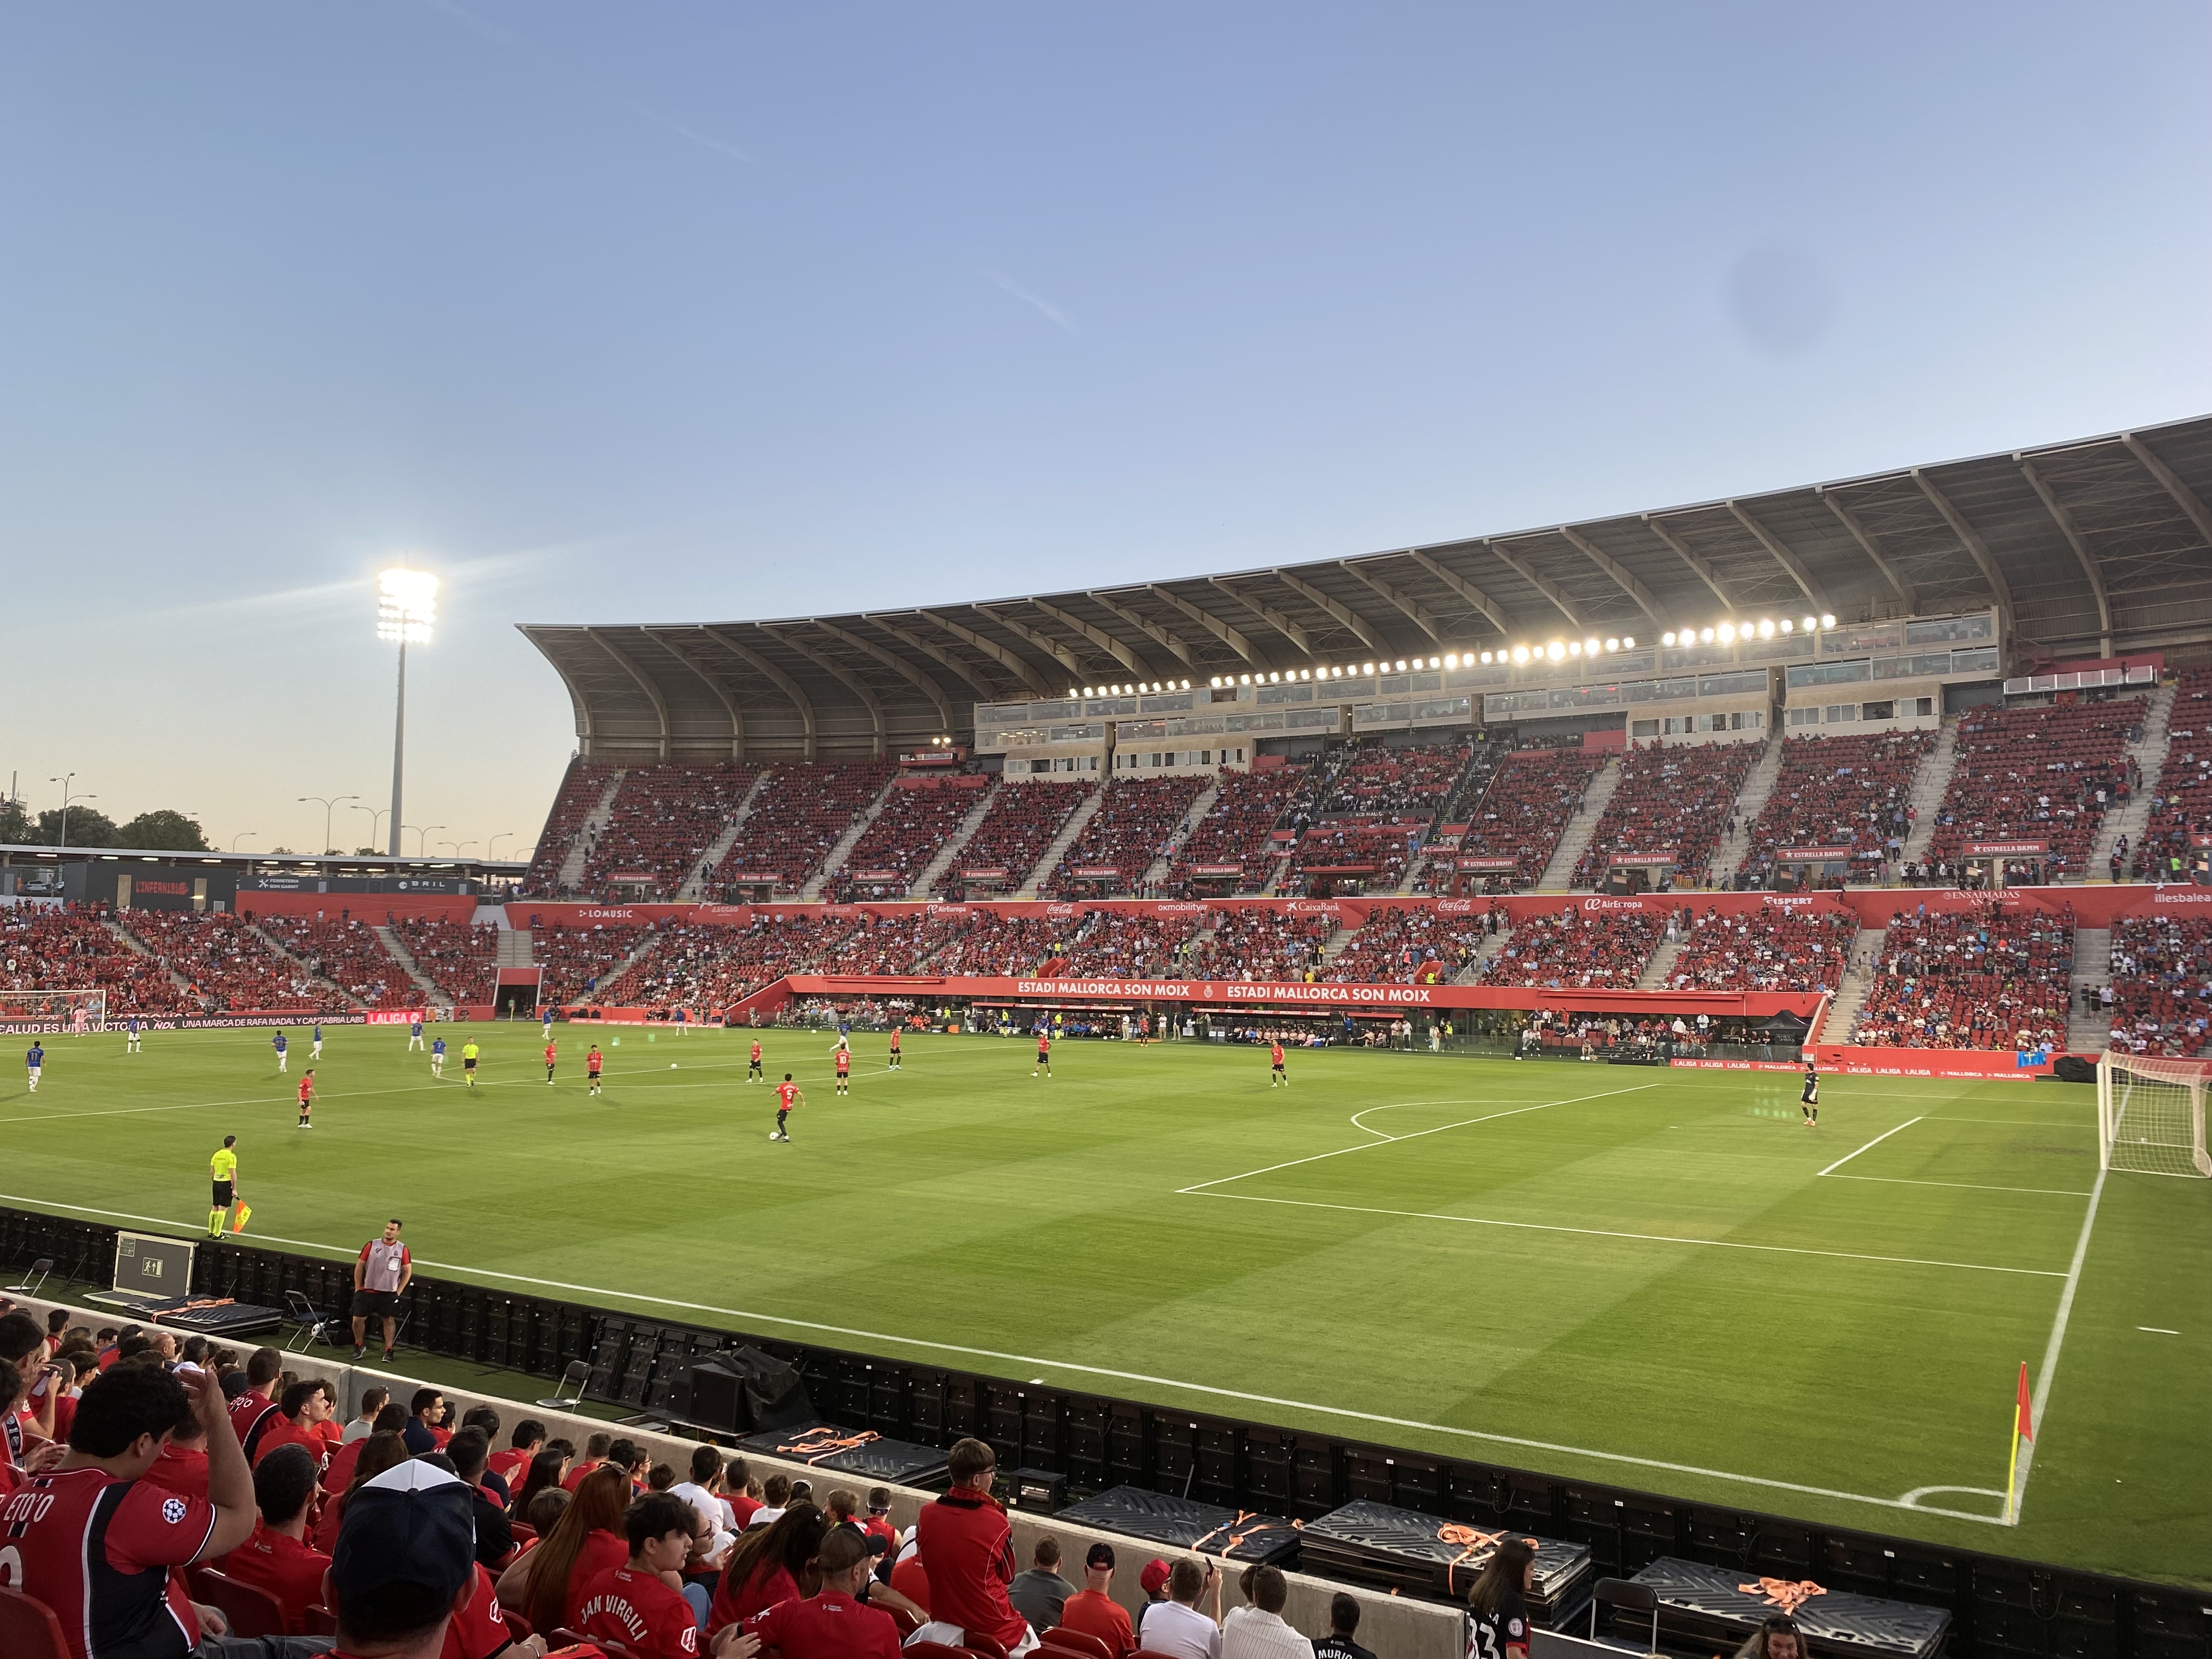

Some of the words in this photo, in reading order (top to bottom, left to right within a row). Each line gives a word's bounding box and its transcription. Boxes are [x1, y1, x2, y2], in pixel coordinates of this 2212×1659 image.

[1953, 890, 2020, 900] ENSAIMADAS
[1047, 904, 1074, 914] Coca-Cola
[1298, 902, 1341, 911] CaixaBank
[1438, 899, 1472, 911] Coca-Cola
[1018, 981, 1055, 992] ESTADI
[1058, 983, 1121, 995] MALLORCA
[1125, 984, 1152, 995] SON
[1154, 984, 1190, 996] MOIX
[1227, 986, 1270, 998] ESTADI
[1273, 987, 1349, 1000] MALLORCA
[1352, 988, 1385, 1001] SON
[1389, 989, 1431, 1002] MOIX
[370, 1013, 408, 1024] LALIGA
[43, 1024, 59, 1033] ES
[182, 1020, 201, 1028] UNA
[202, 1019, 234, 1028] MARCA
[247, 1018, 268, 1026] RAFA
[269, 1017, 296, 1025] NADAL
[302, 1016, 346, 1025] CANTABRIA
[31, 1052, 38, 1061] 11
[839, 1056, 846, 1064] 10
[787, 1090, 792, 1100] 5
[3, 1493, 54, 1522] ETO'O
[581, 1595, 602, 1624] JAN
[605, 1595, 647, 1641] VIRGILI
